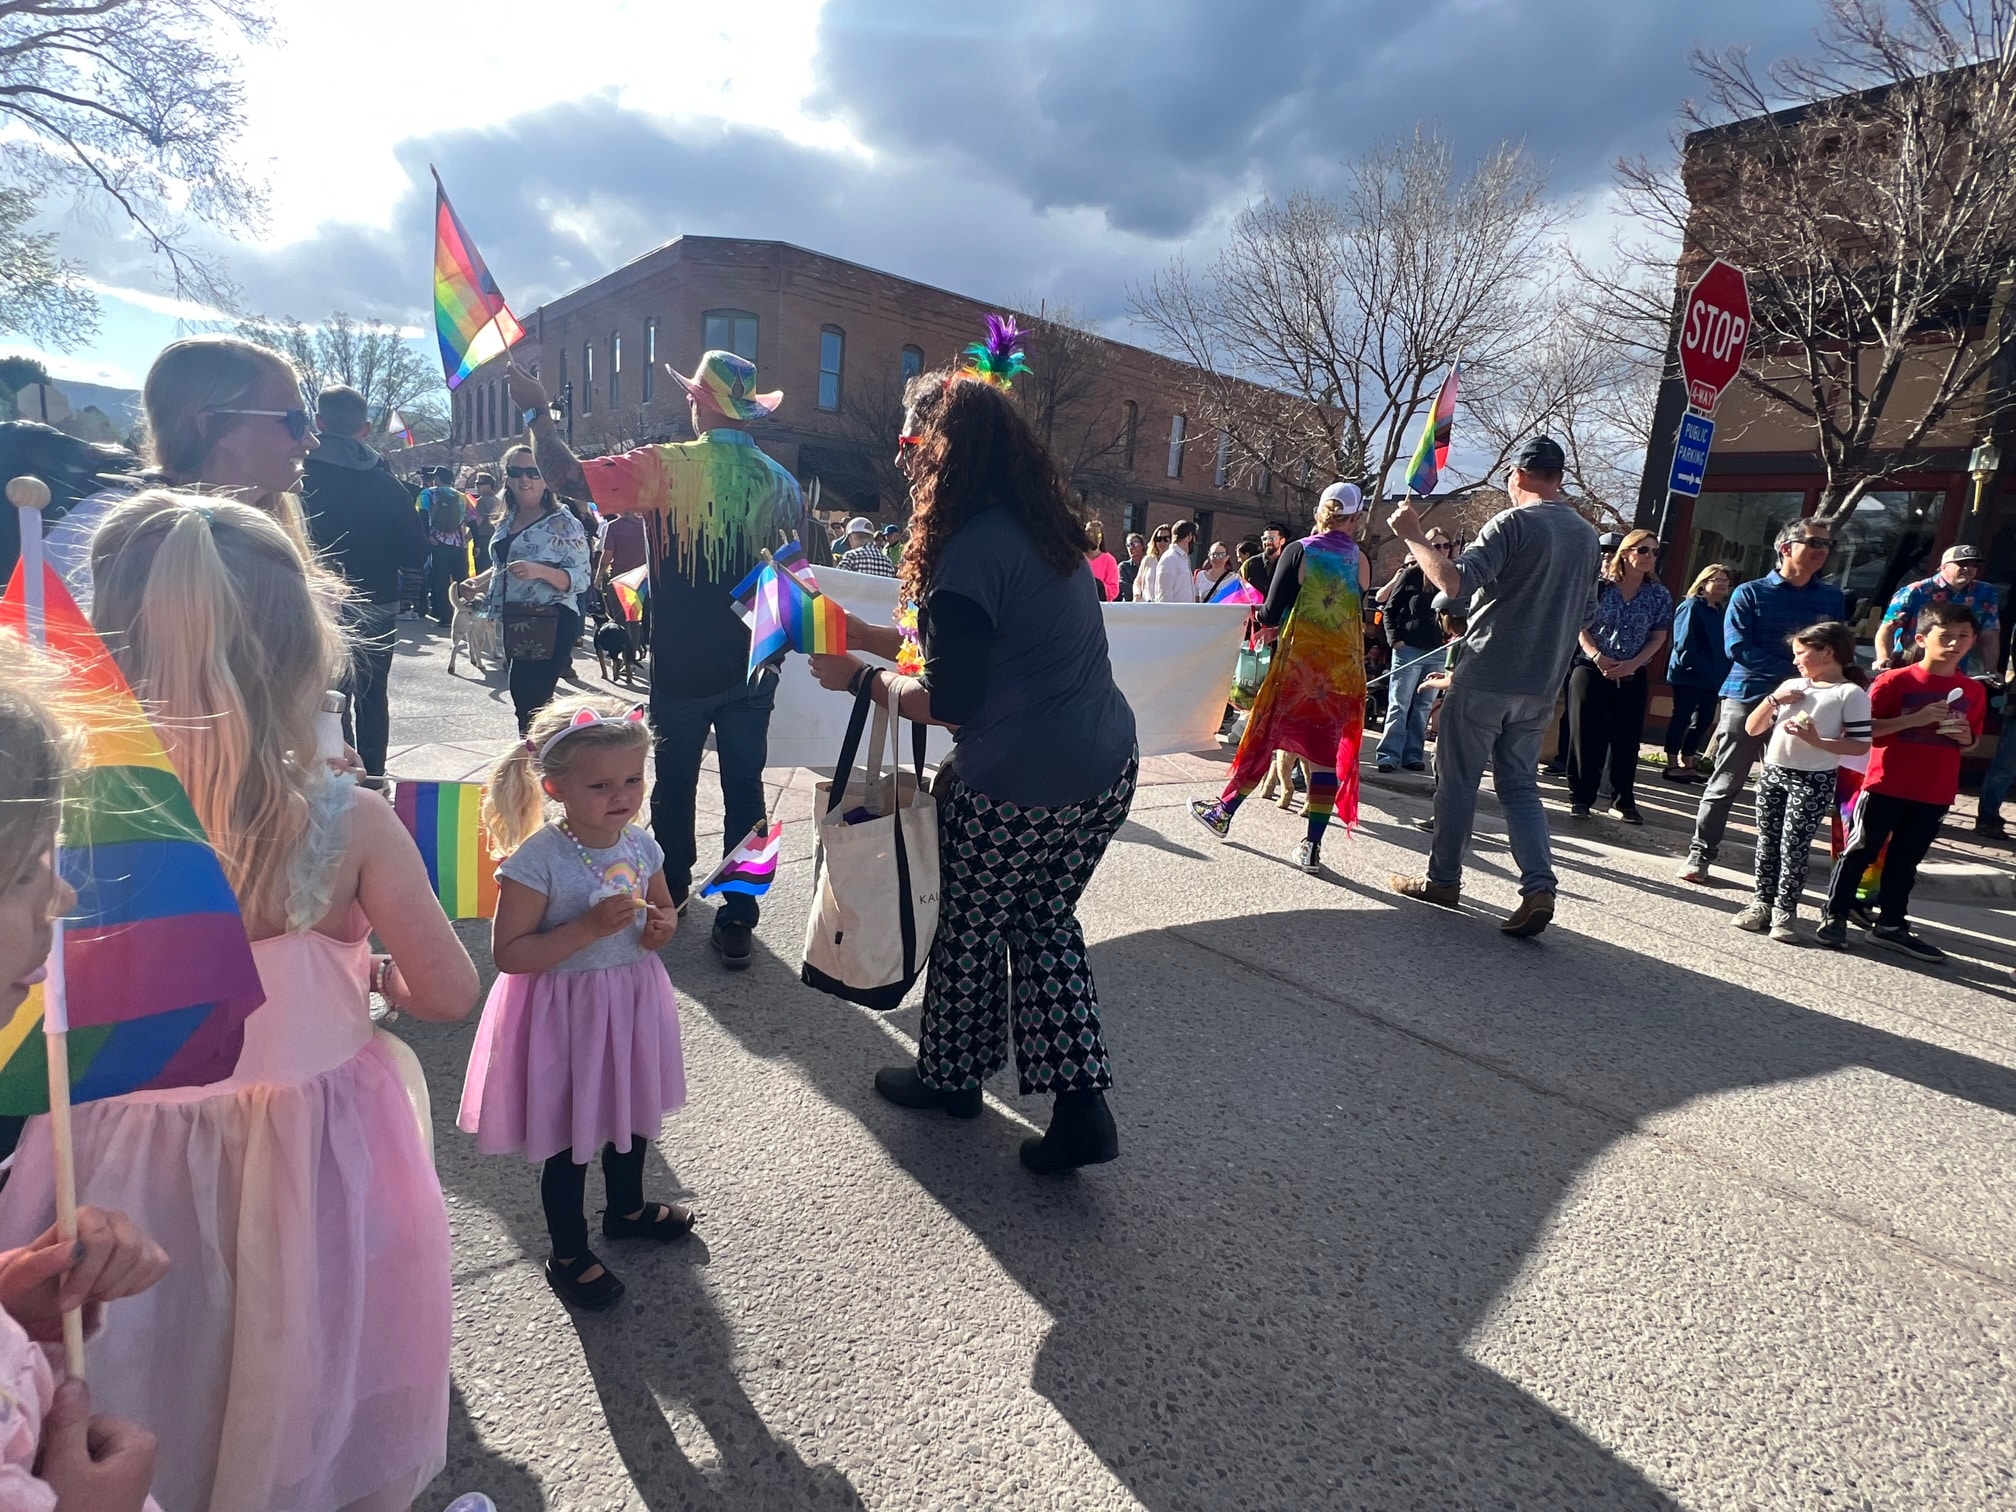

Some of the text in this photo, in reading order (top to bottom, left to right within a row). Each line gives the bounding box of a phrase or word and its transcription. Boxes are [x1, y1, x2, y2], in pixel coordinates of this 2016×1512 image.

[1686, 300, 1745, 362] STOP
[1691, 386, 1714, 406] 4-WAY
[1684, 423, 1708, 443] PUBLIC
[1678, 445, 1704, 466] PARKING
